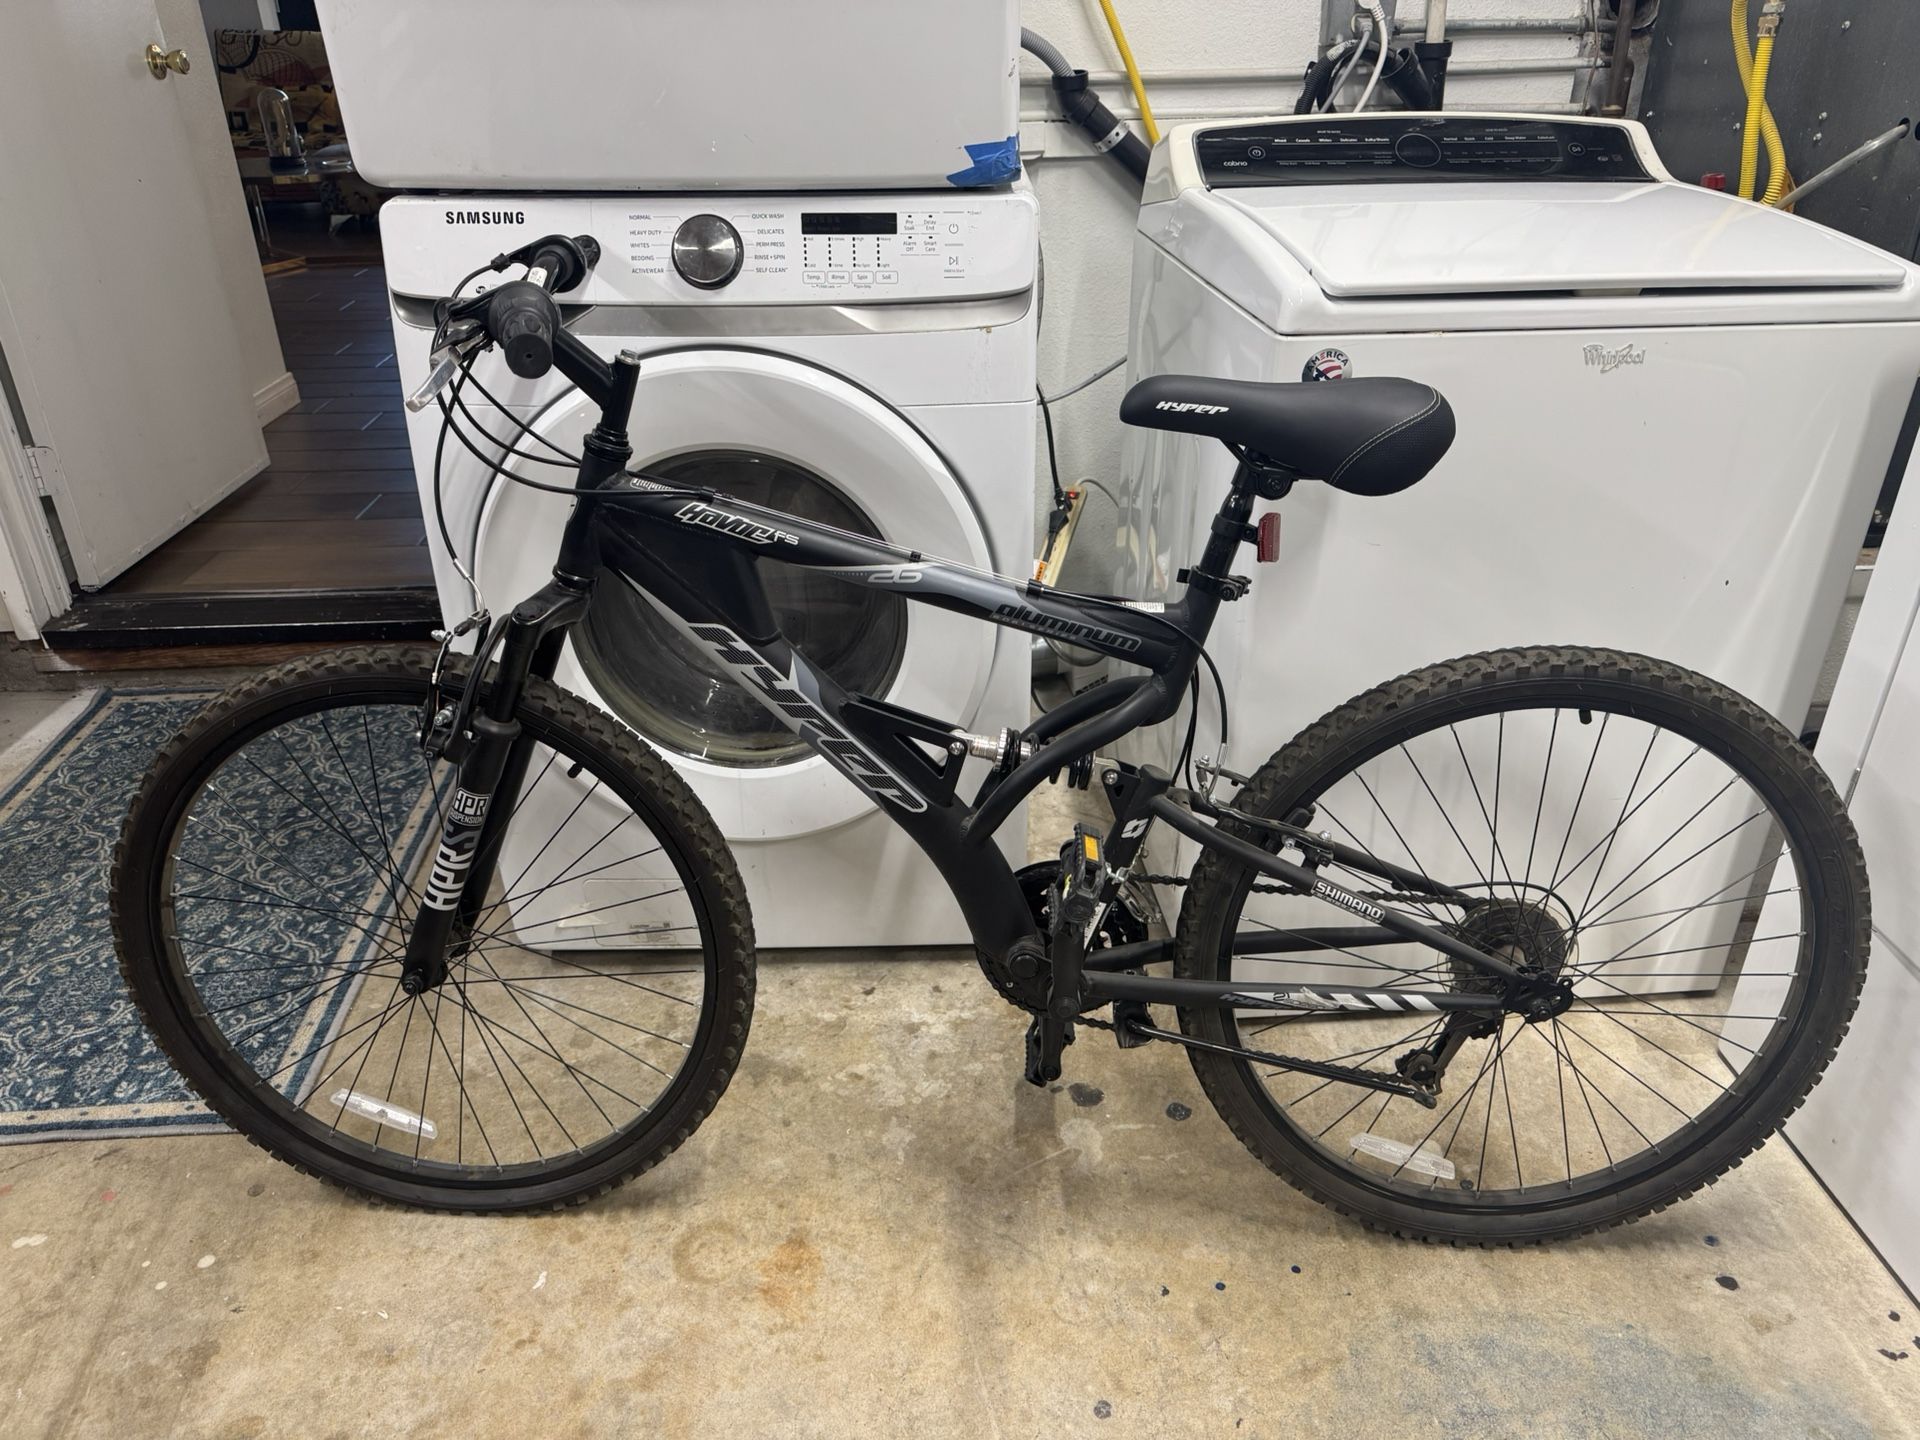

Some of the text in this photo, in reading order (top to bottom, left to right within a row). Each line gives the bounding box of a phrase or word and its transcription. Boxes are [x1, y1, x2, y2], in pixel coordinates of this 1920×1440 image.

[445, 211, 525, 225] SAMSUNG
[1306, 350, 1350, 373] AMERICA
[1582, 343, 1646, 374] Whirlpool
[674, 502, 800, 546] Havoc FS
[867, 569, 924, 584] 26
[993, 603, 1143, 652] aluminum
[452, 789, 491, 816] HPR
[1315, 881, 1384, 920] SHIMANO
